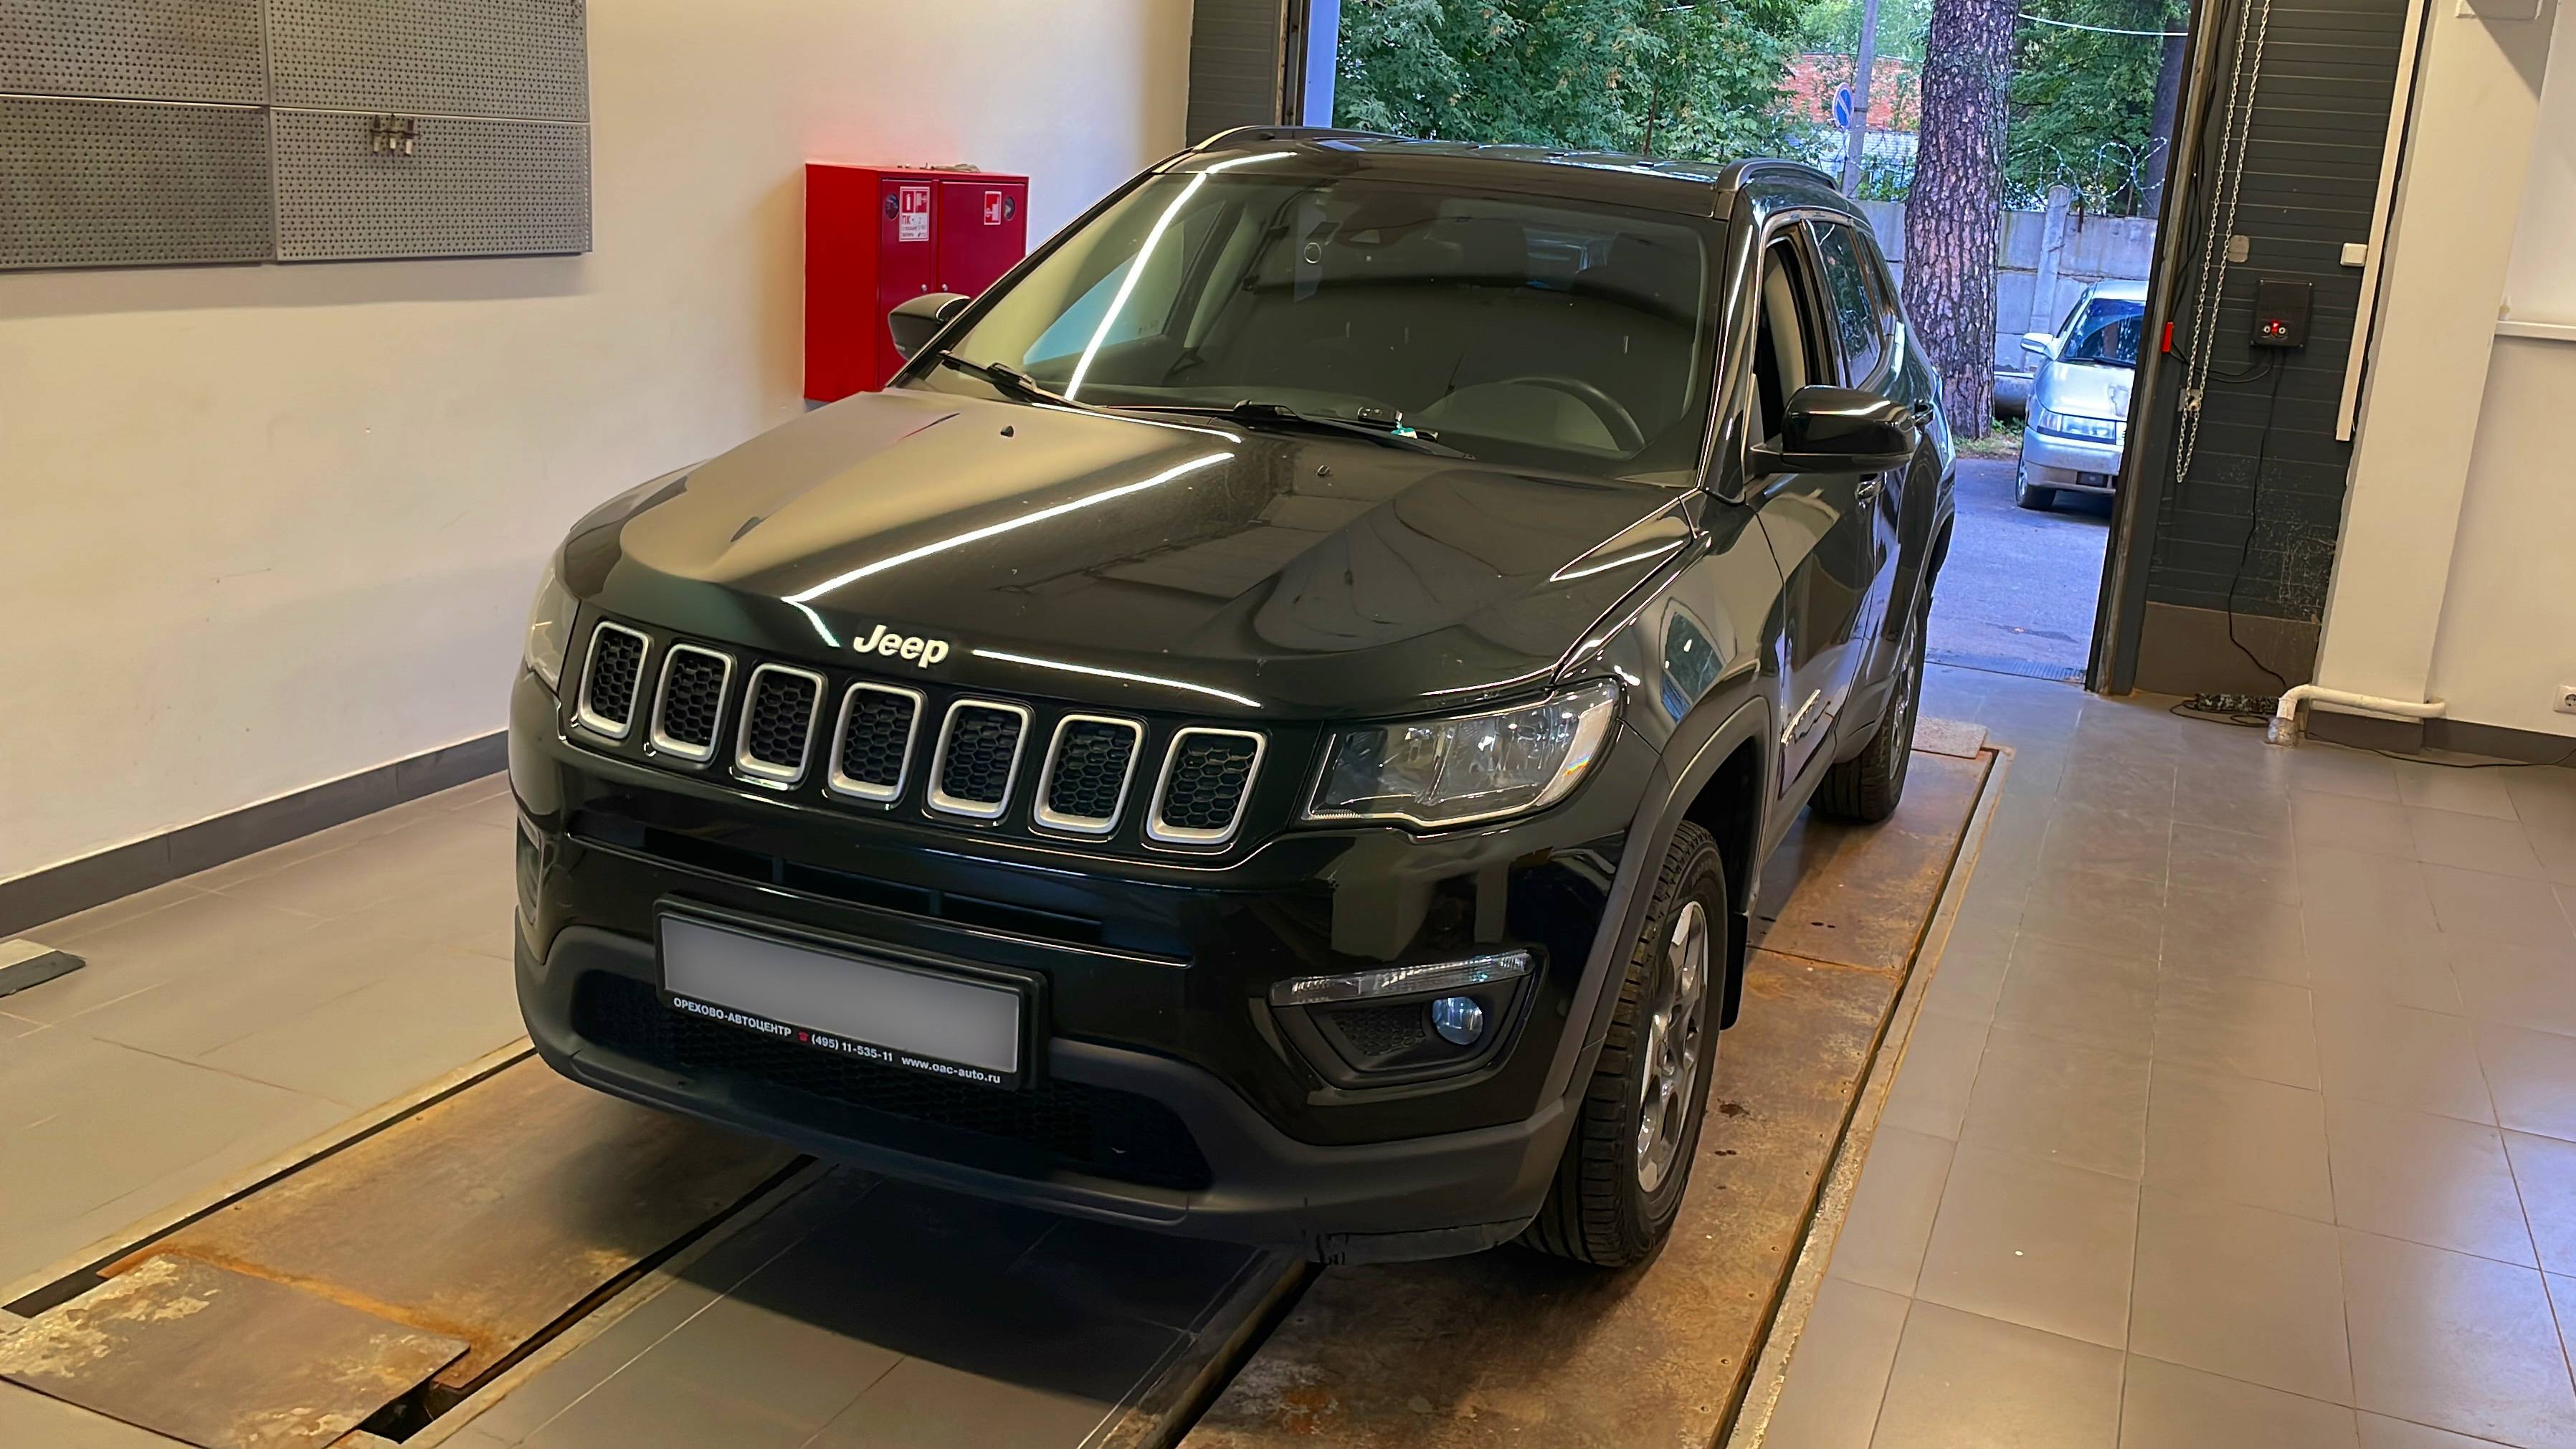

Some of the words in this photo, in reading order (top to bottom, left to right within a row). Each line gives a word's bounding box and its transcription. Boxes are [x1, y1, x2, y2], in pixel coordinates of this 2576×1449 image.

[853, 624, 949, 669] Jeep
[673, 997, 792, 1036] ОРЕХОВО-АВТОЦЕНТР
[811, 1034, 839, 1050] (495)
[842, 1042, 893, 1062] 11-535-11
[901, 1056, 1001, 1083] www.oac-auto.ru
